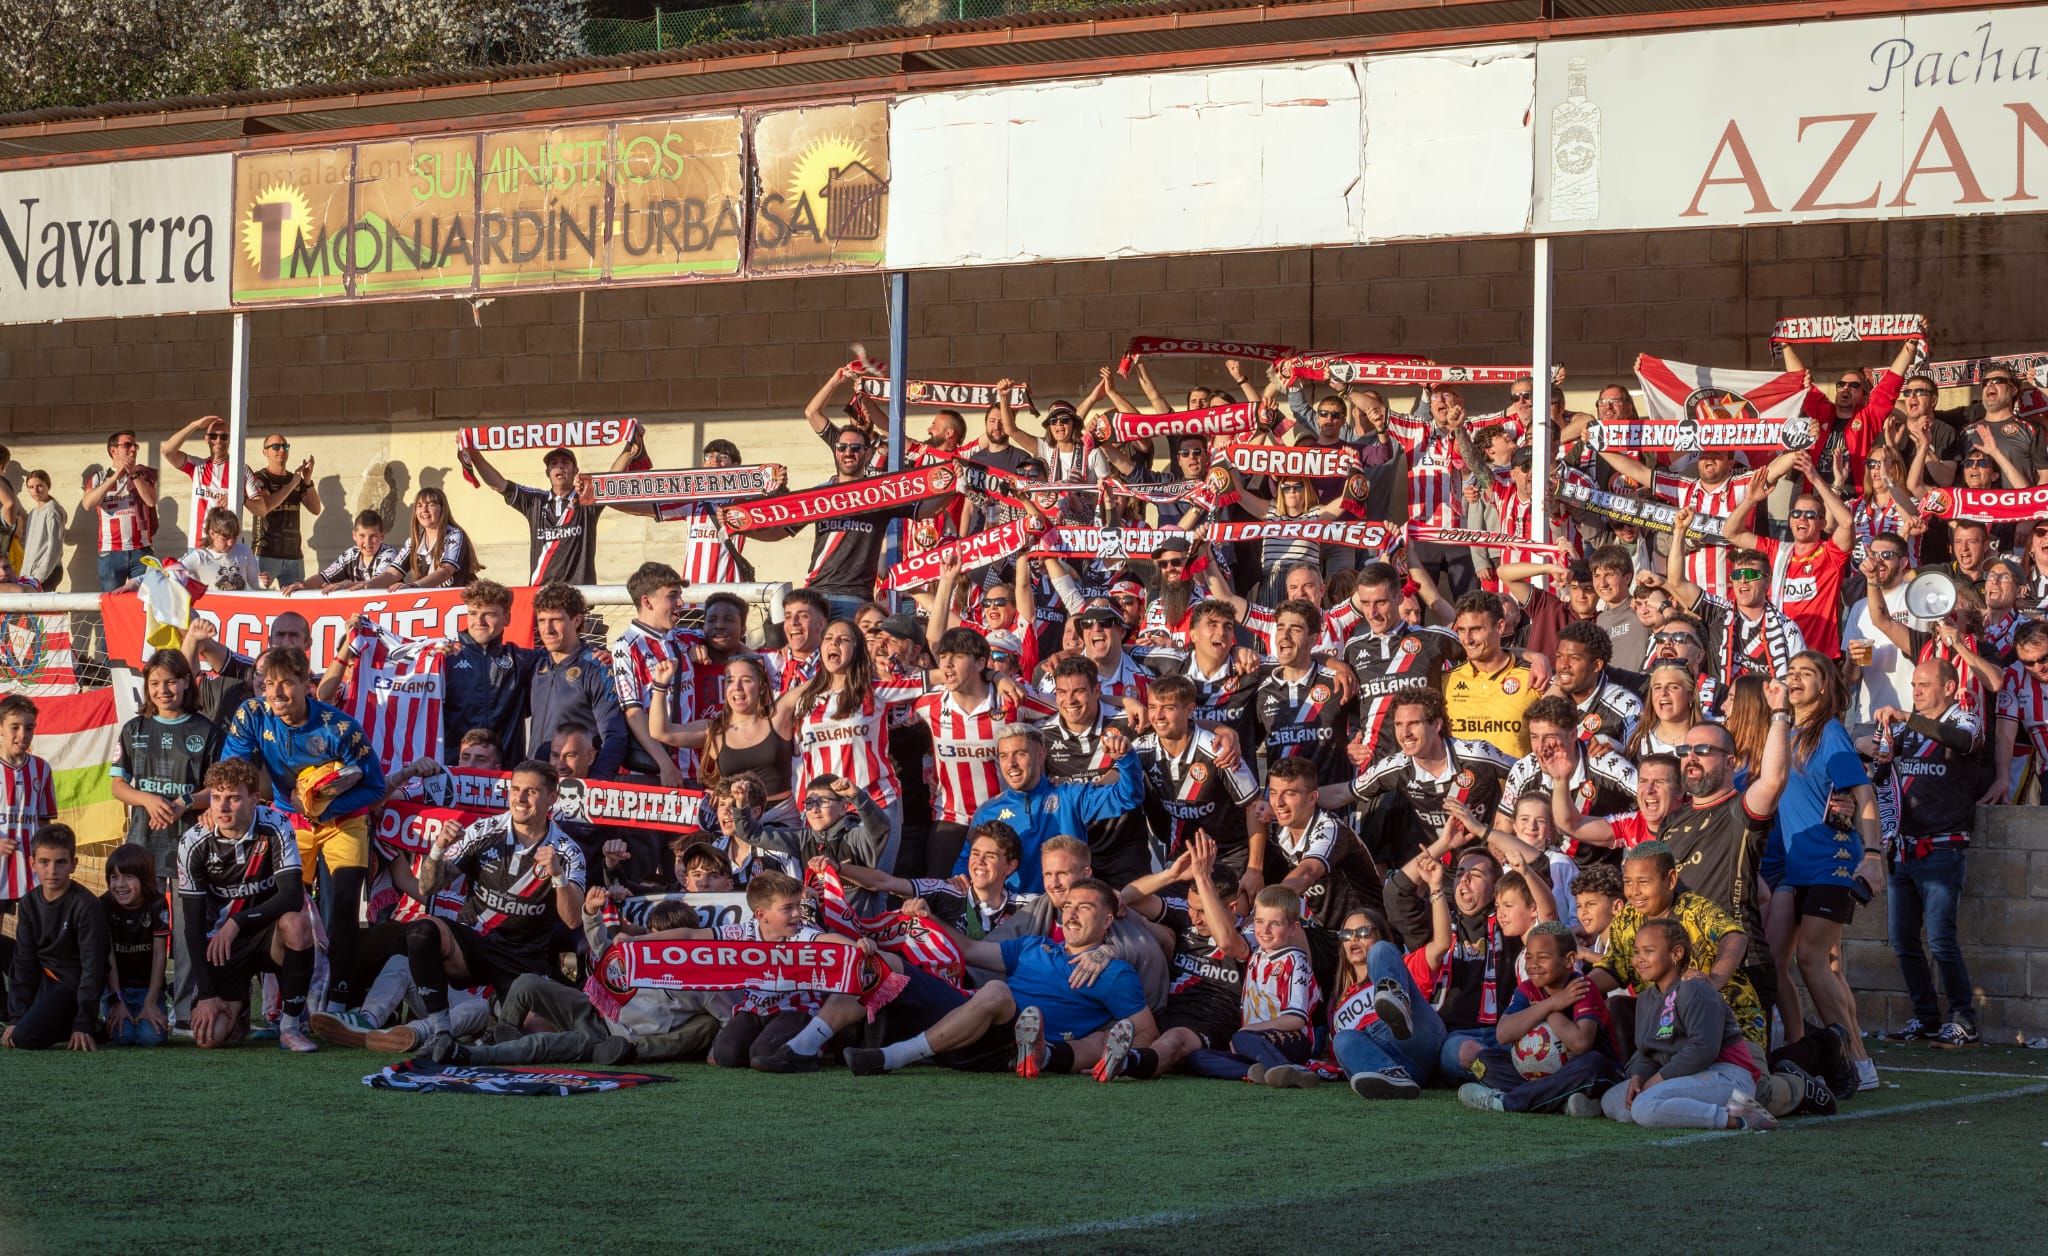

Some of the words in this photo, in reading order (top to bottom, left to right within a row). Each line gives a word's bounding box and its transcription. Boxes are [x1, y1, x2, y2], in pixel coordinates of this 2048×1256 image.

[412, 133, 684, 200] SUMINISTROS
[0, 198, 214, 292] Navarra
[1610, 427, 1677, 447] ETERNO
[1701, 420, 1780, 446] CAPITÁN
[1234, 448, 1350, 476] OGROÑÉS
[593, 470, 764, 498] LOGROENFERMOS
[750, 503, 797, 525] S.D.
[801, 475, 926, 517] LOGROÑÉS
[1967, 488, 2048, 506] LOGRO
[830, 521, 873, 534] BLANCO
[1611, 623, 1630, 635] NZIE
[392, 681, 436, 694] BLANO
[1371, 676, 1429, 698] BLANCO
[816, 725, 869, 742] BLANCO
[1281, 727, 1333, 747] BLANCO
[1468, 720, 1521, 733] BLANCO
[957, 746, 996, 758] BLAN
[1902, 763, 1946, 776] BLANCO
[589, 787, 699, 825] CAPITÁN
[228, 876, 276, 898] BANCO
[486, 893, 546, 916] BLANCO
[642, 944, 837, 967] LOGROÑÉS
[1184, 960, 1239, 984] BLANCO
[1338, 992, 1373, 1028] RIOJ
